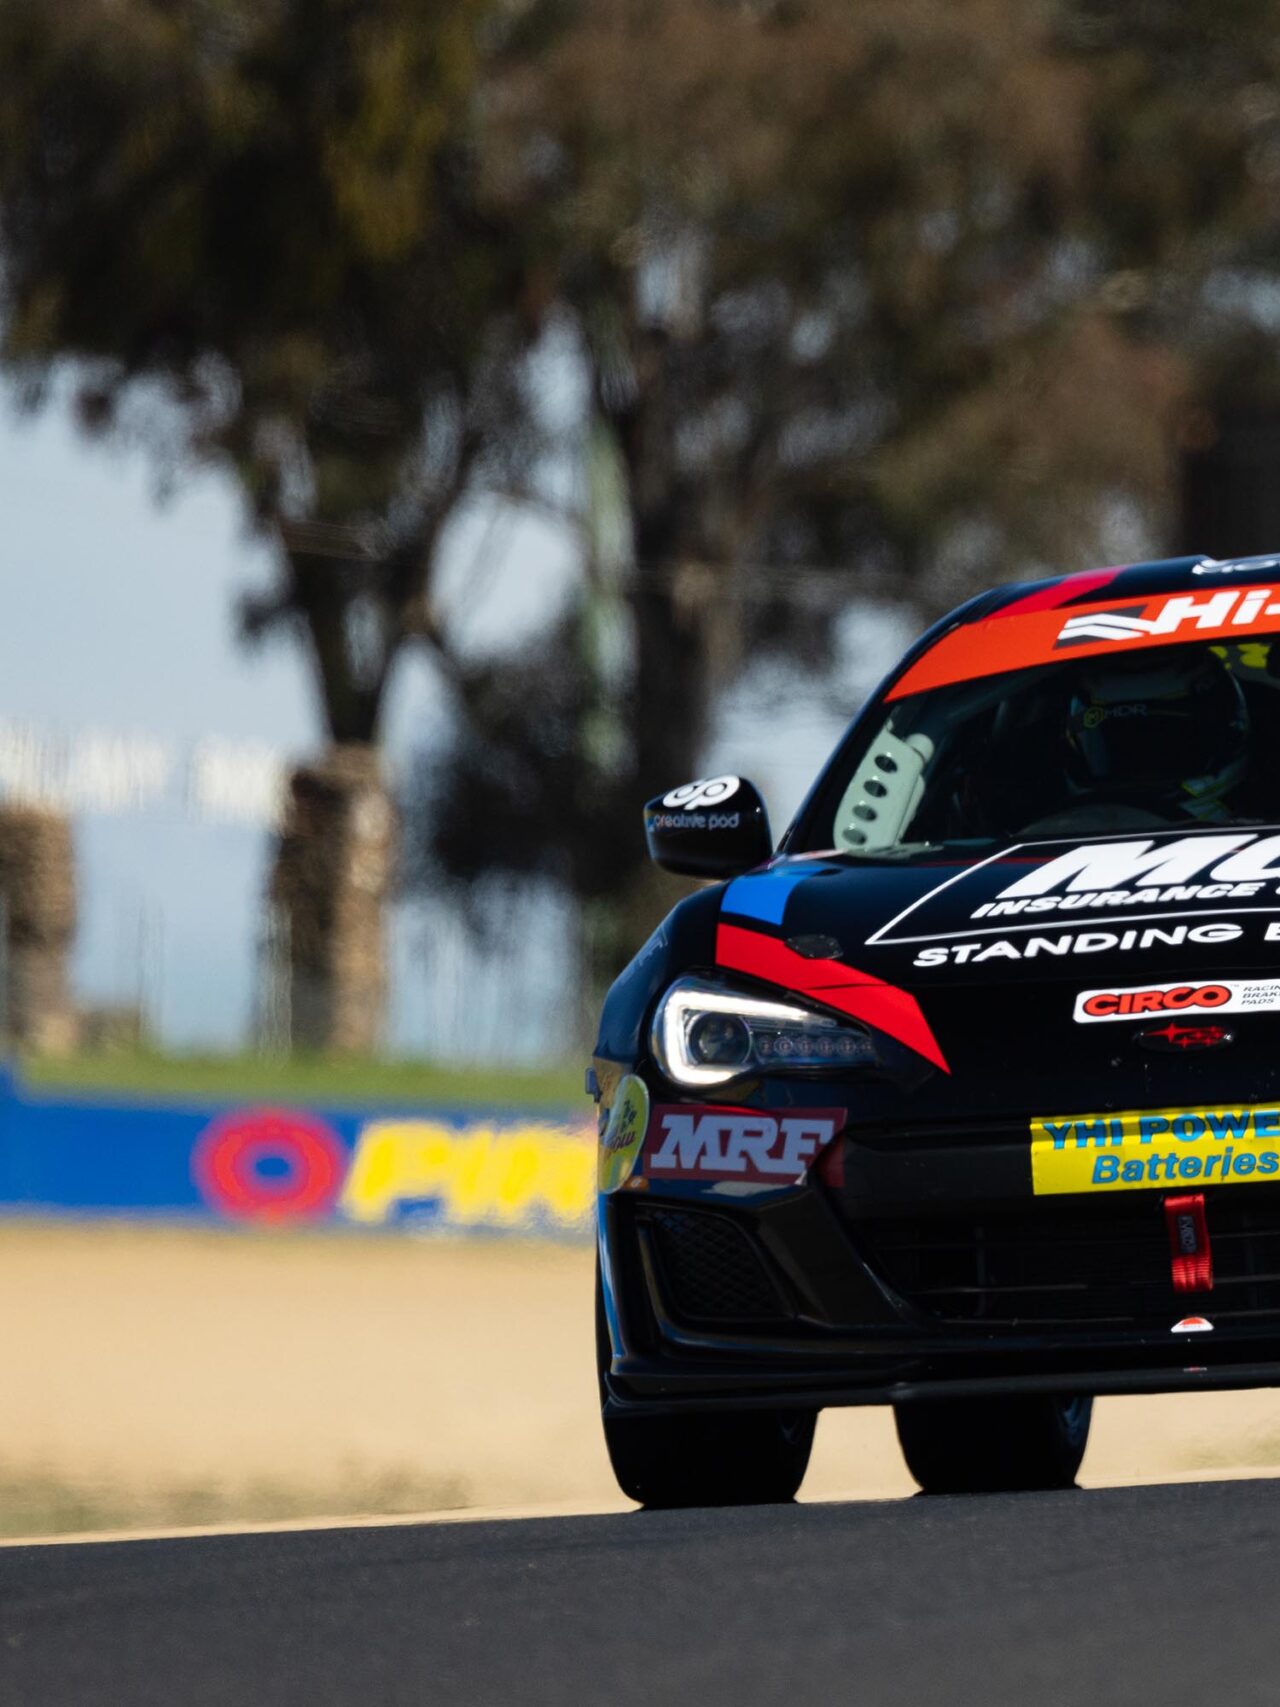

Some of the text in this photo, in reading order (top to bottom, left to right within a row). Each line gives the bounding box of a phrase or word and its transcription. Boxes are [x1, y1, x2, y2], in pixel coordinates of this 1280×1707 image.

[970, 882, 1266, 919] INSURANCE
[913, 923, 1244, 967] STANDING
[1082, 984, 1233, 1017] CIRCO
[1241, 998, 1276, 1006] PADS
[651, 1114, 834, 1174] MRF
[1043, 1118, 1125, 1149] YHI
[1092, 1147, 1280, 1184] Batteries
